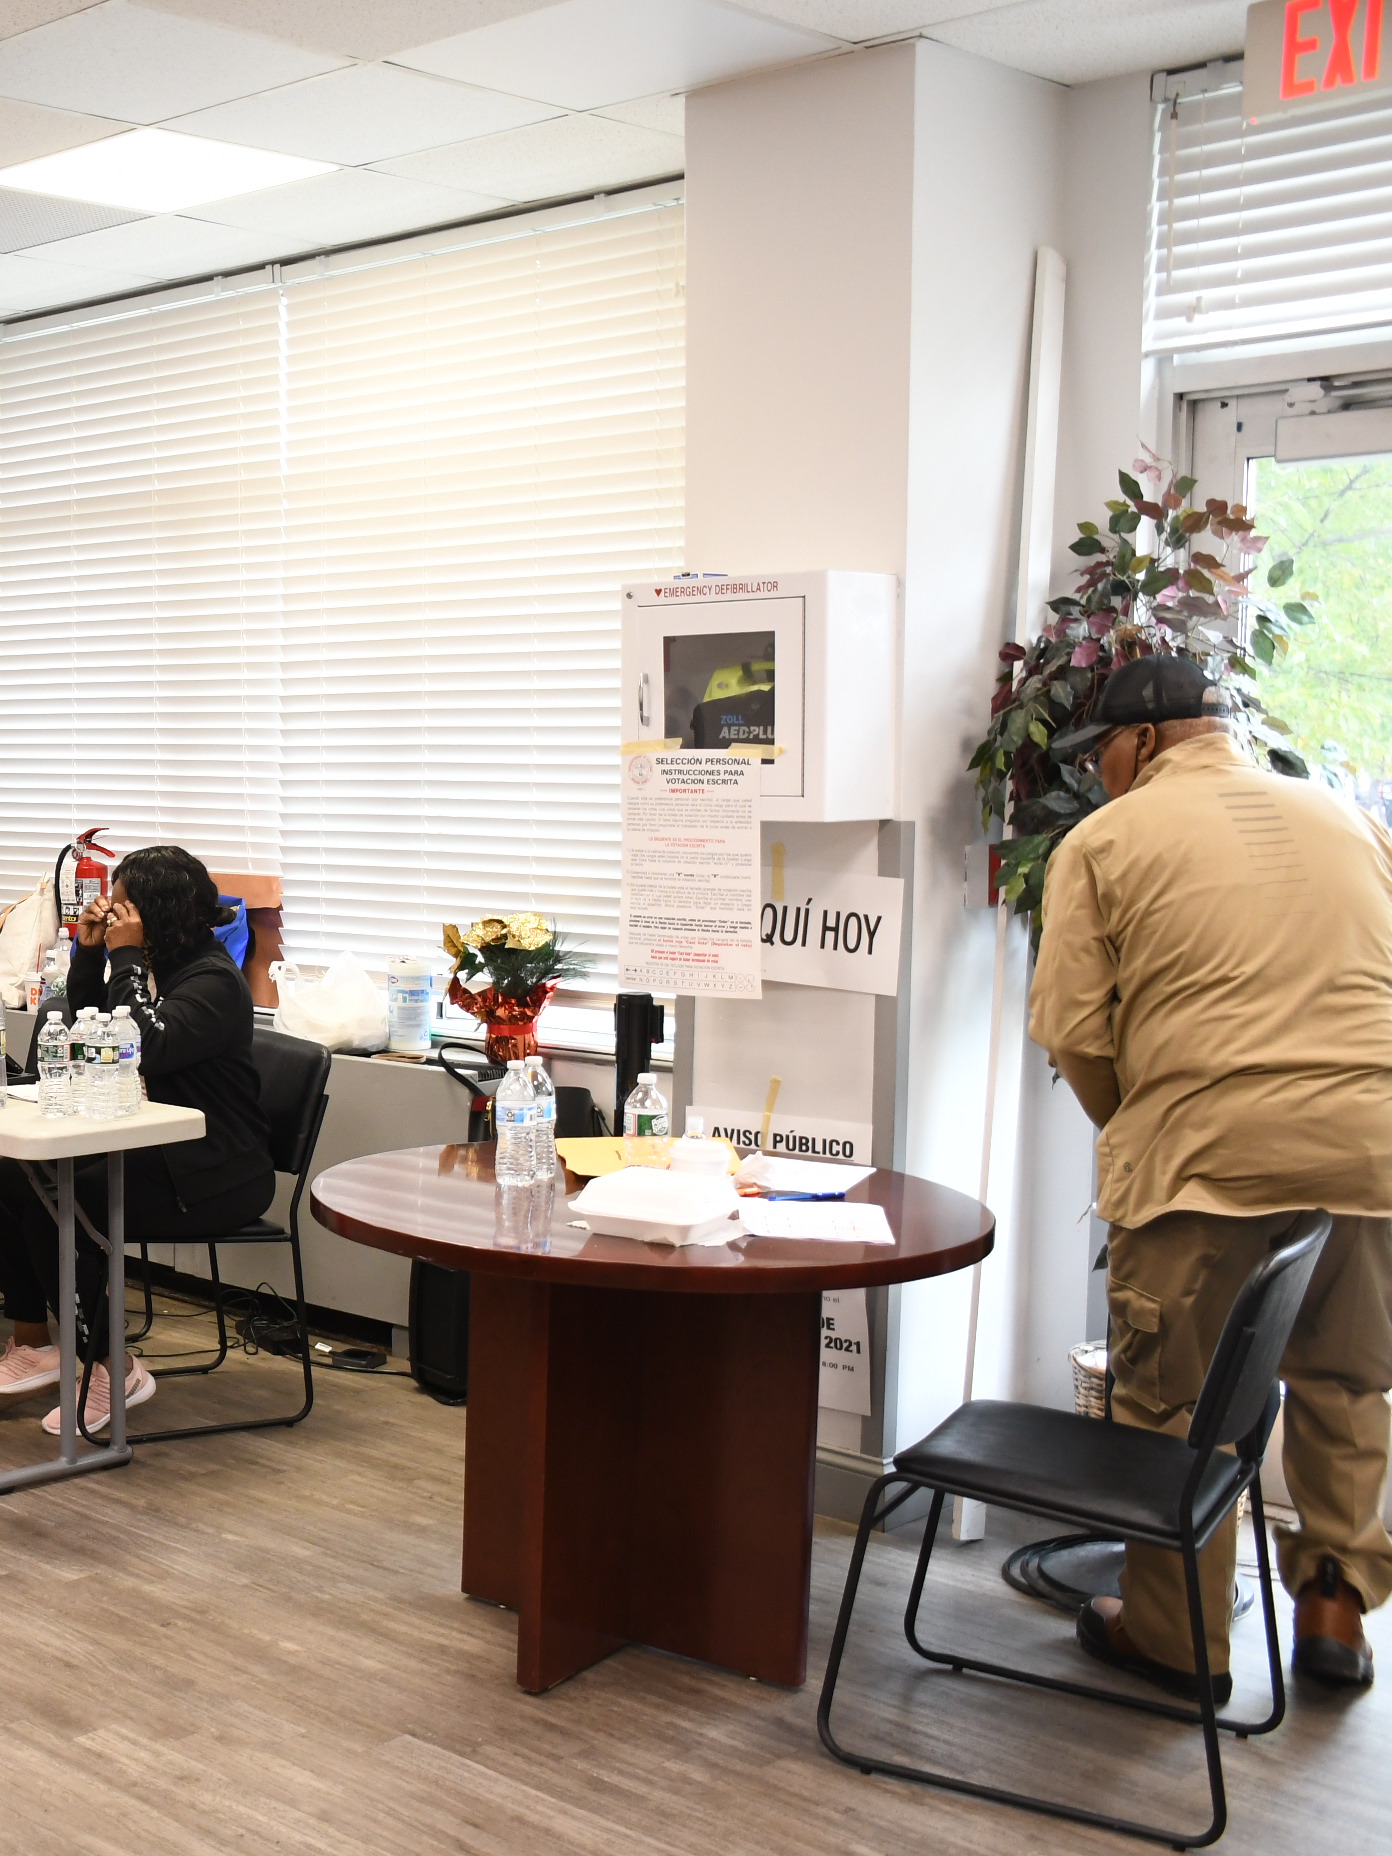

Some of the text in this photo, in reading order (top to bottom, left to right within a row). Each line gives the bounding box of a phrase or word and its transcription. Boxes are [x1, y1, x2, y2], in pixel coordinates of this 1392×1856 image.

[1280, 0, 1384, 101] EXI
[663, 581, 779, 599] EMERGENCY DEFIBRILLATOR
[720, 715, 744, 725] ZOLL
[655, 755, 752, 767] SELECCIÓN PERSONAL
[660, 768, 745, 778] INSTRUCCIONES PARA
[706, 778, 739, 786] ESCRITA
[820, 909, 883, 956] HOY
[772, 1129, 854, 1159] PÚBLICO
[824, 1335, 861, 1355] 2021
[842, 1364, 855, 1373] PM
